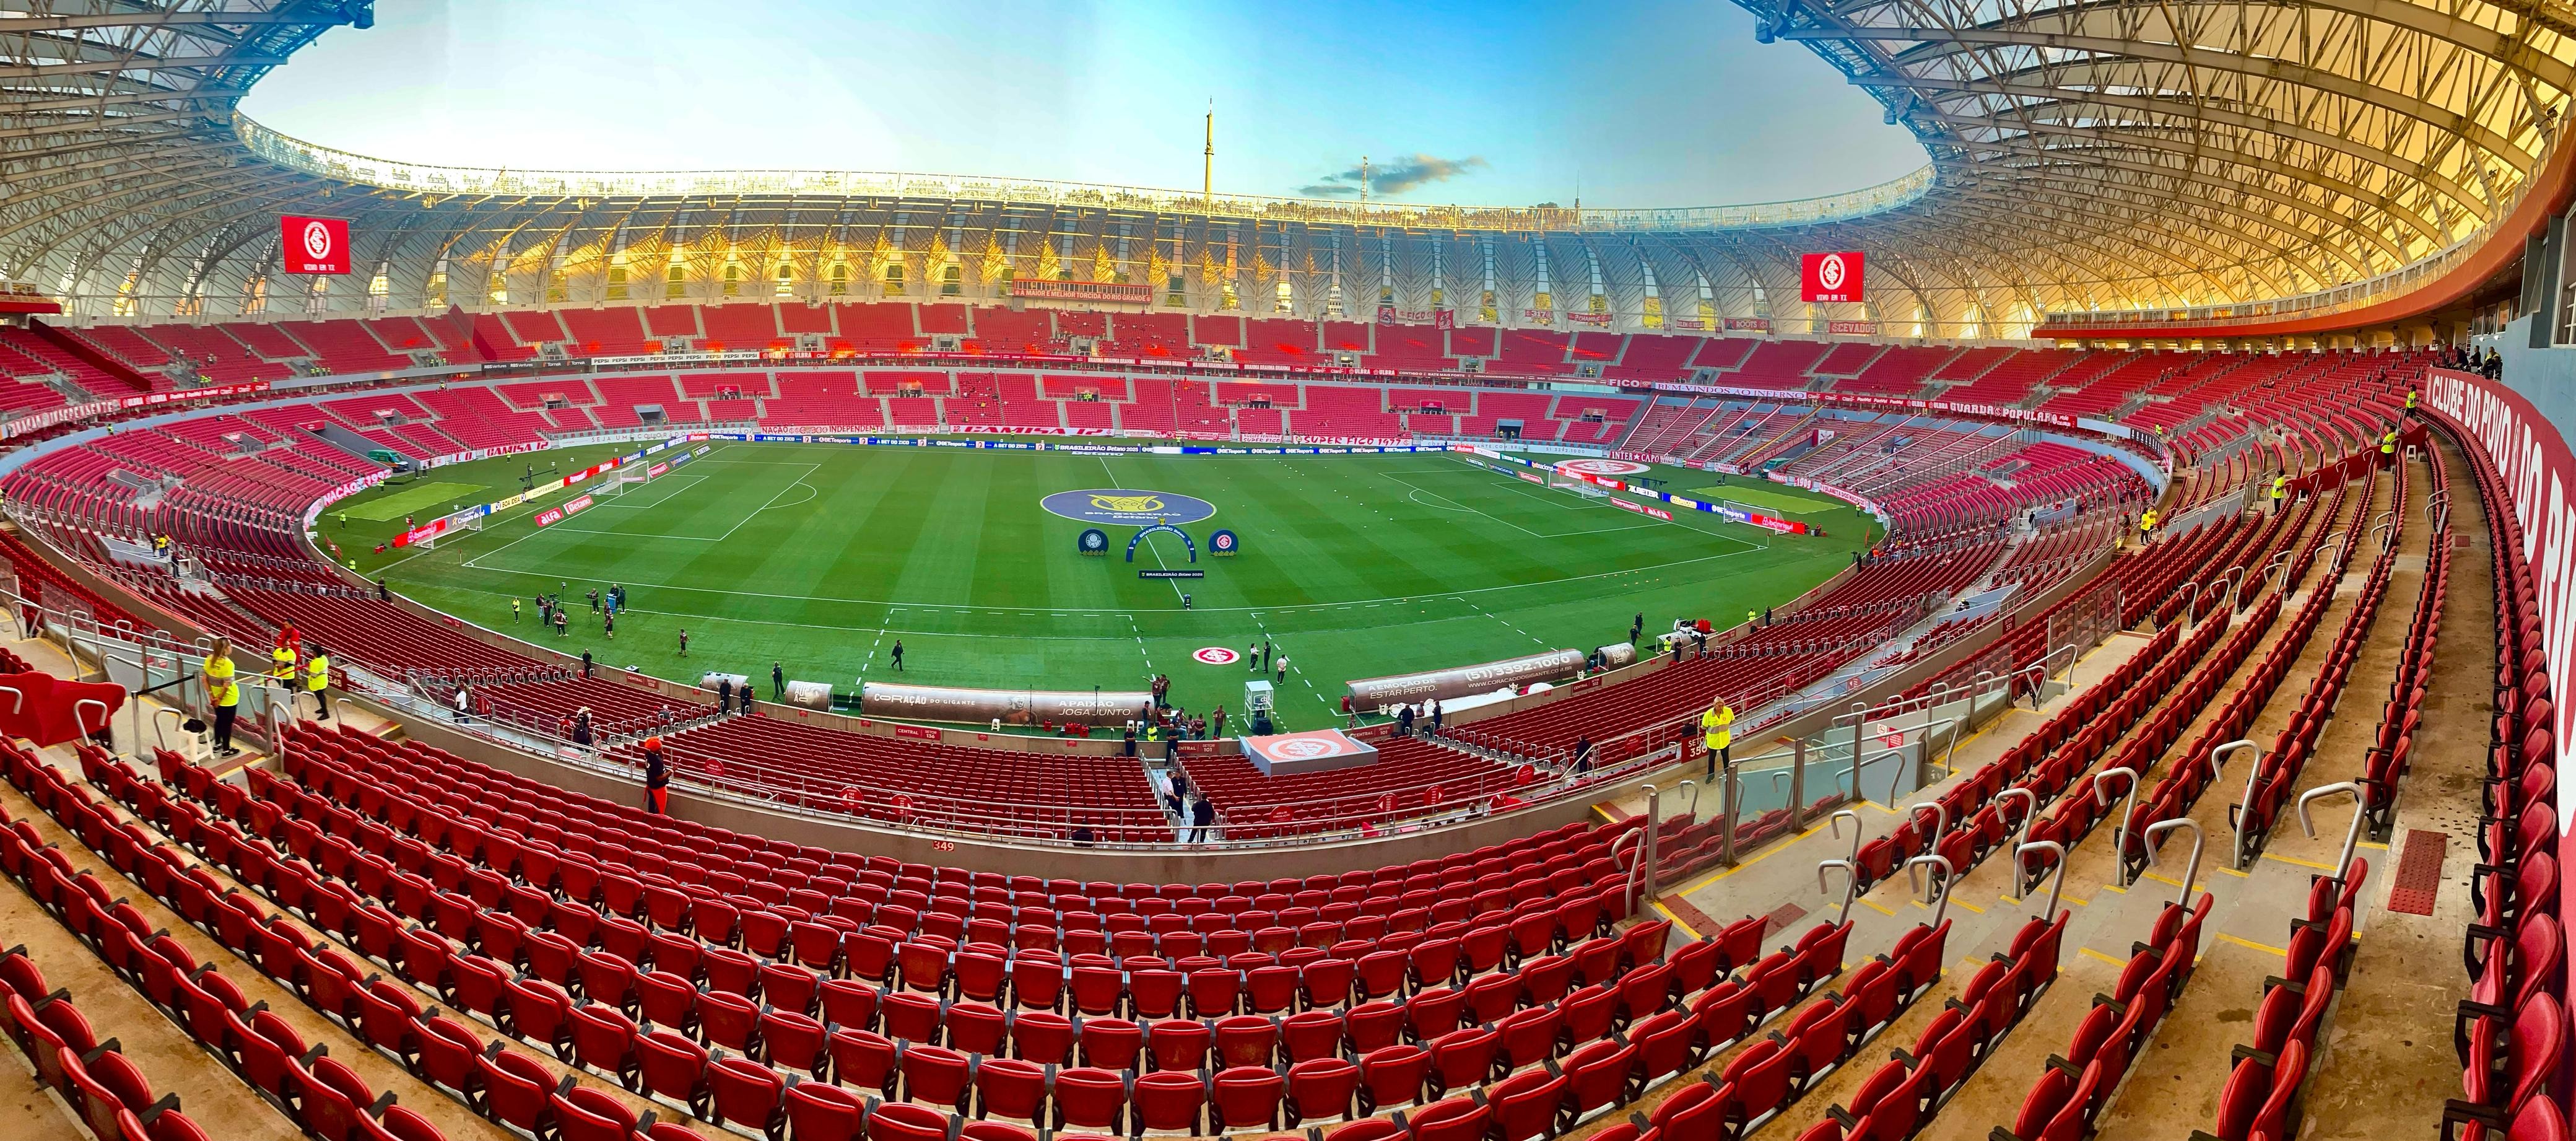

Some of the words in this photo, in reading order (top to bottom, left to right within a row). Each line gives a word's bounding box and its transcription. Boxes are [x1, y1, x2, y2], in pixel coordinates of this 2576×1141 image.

[1838, 323, 1876, 333] CEVADOS
[1609, 379, 1640, 388] FICO
[1658, 383, 1730, 395] BEM-VINDOS
[1754, 390, 1804, 399] INFERNO
[1950, 403, 1993, 415] GUARDA
[2003, 409, 2052, 422] POPULAR
[762, 426, 788, 434] NAÇÃO
[964, 426, 1066, 435] CAMISA
[1304, 436, 1342, 444] SUPER
[487, 444, 531, 457] CAMISA
[536, 442, 549, 450] 12
[670, 453, 691, 467] betnacional
[1612, 451, 1632, 461] INTER
[1641, 453, 1660, 463] CAPO
[2432, 374, 2463, 420] CLUBE
[2465, 385, 2481, 429] DO
[2481, 390, 2512, 475] POVO
[2517, 423, 2544, 564] DO
[1797, 477, 1811, 489] 1909
[568, 498, 591, 512] Betano
[1611, 499, 1639, 510] SUPERBET
[458, 513, 474, 524] Cruzeiro
[541, 510, 561, 525] alfa
[1647, 508, 1668, 519] alfa
[1717, 506, 1745, 519] BETesporte
[1769, 519, 1793, 530] banrisul
[1139, 527, 1173, 538] BRASILEIRÃO
[1174, 529, 1185, 539] Betano
[2004, 617, 2012, 625] SETOR
[1466, 668, 1494, 681] (51)
[1495, 655, 1570, 676] 3392.1000
[329, 676, 342, 687] 348
[1468, 666, 1572, 688] WWW.CORACAODOGIGANTE.COM.BR
[1375, 679, 1422, 690] EMOÇÃO
[1370, 690, 1403, 699] ESTAR
[1403, 685, 1437, 696] PERTO.
[874, 693, 926, 706] CORAÇÃO
[1690, 746, 1708, 757] 350
[934, 841, 954, 851] 349
